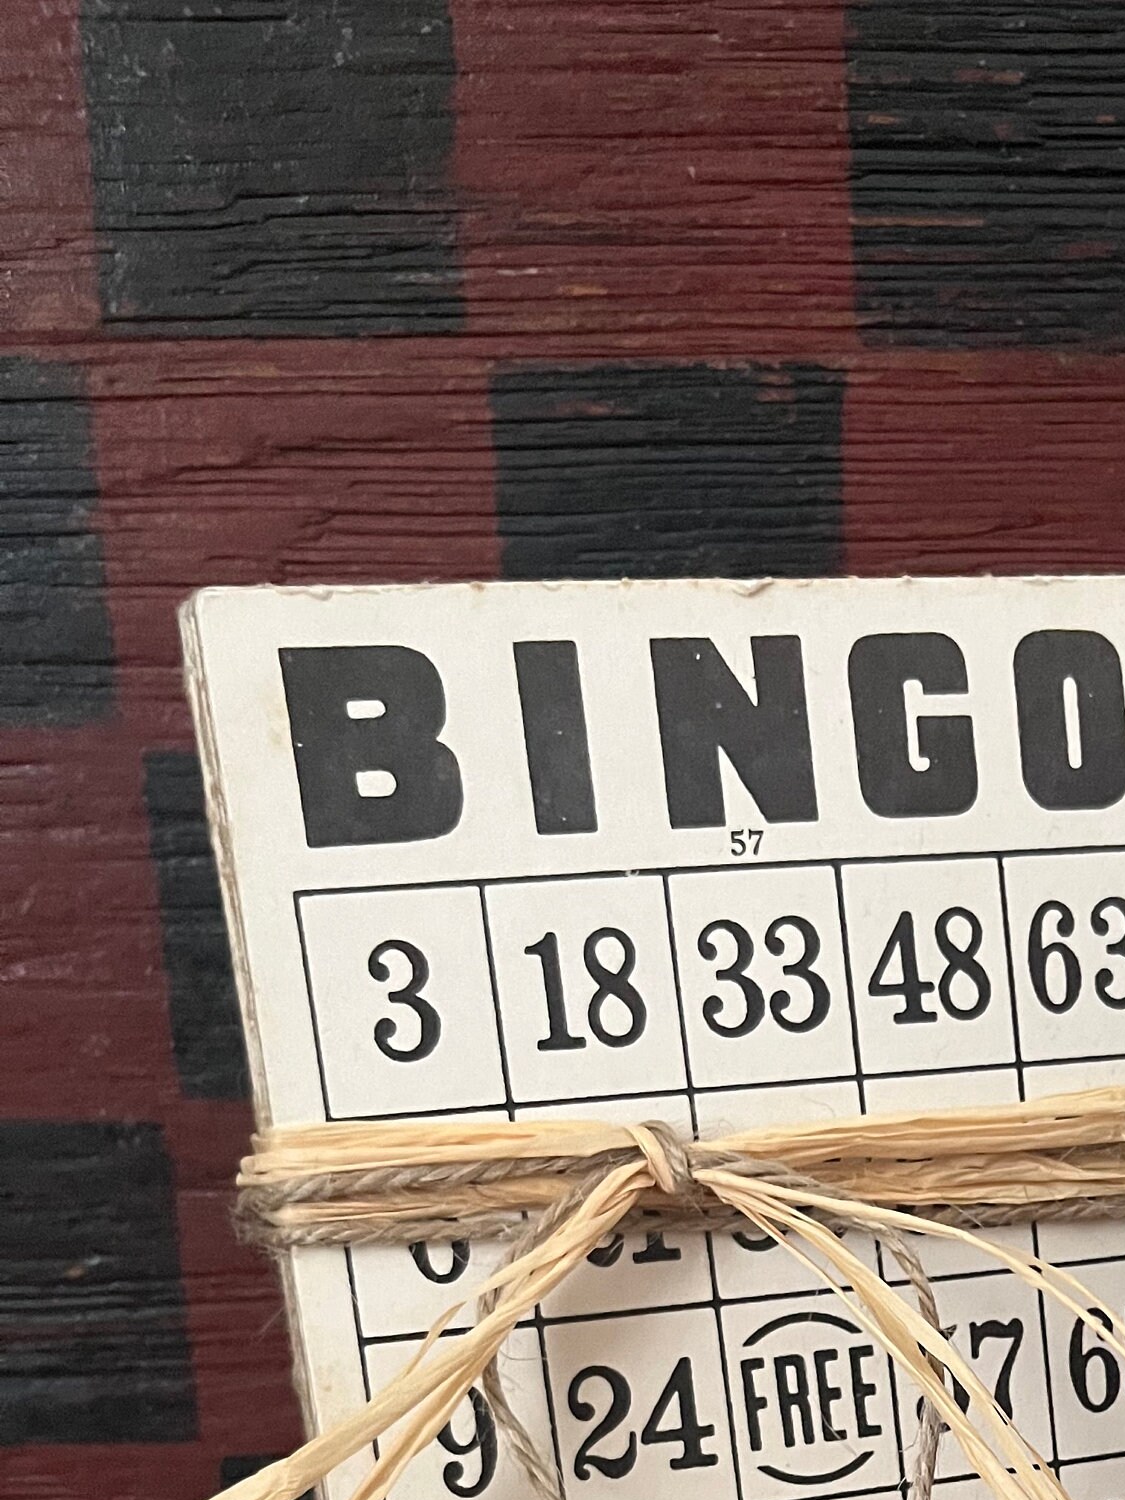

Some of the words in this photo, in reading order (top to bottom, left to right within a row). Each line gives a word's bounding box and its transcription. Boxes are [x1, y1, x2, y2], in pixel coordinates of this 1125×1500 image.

[729, 829, 764, 857] 57
[368, 939, 441, 1063] 3
[524, 927, 648, 1053] 18
[696, 914, 832, 1038] 33
[868, 906, 992, 1026] 48
[567, 1356, 719, 1482] 24
[739, 1345, 883, 1453] FREE
